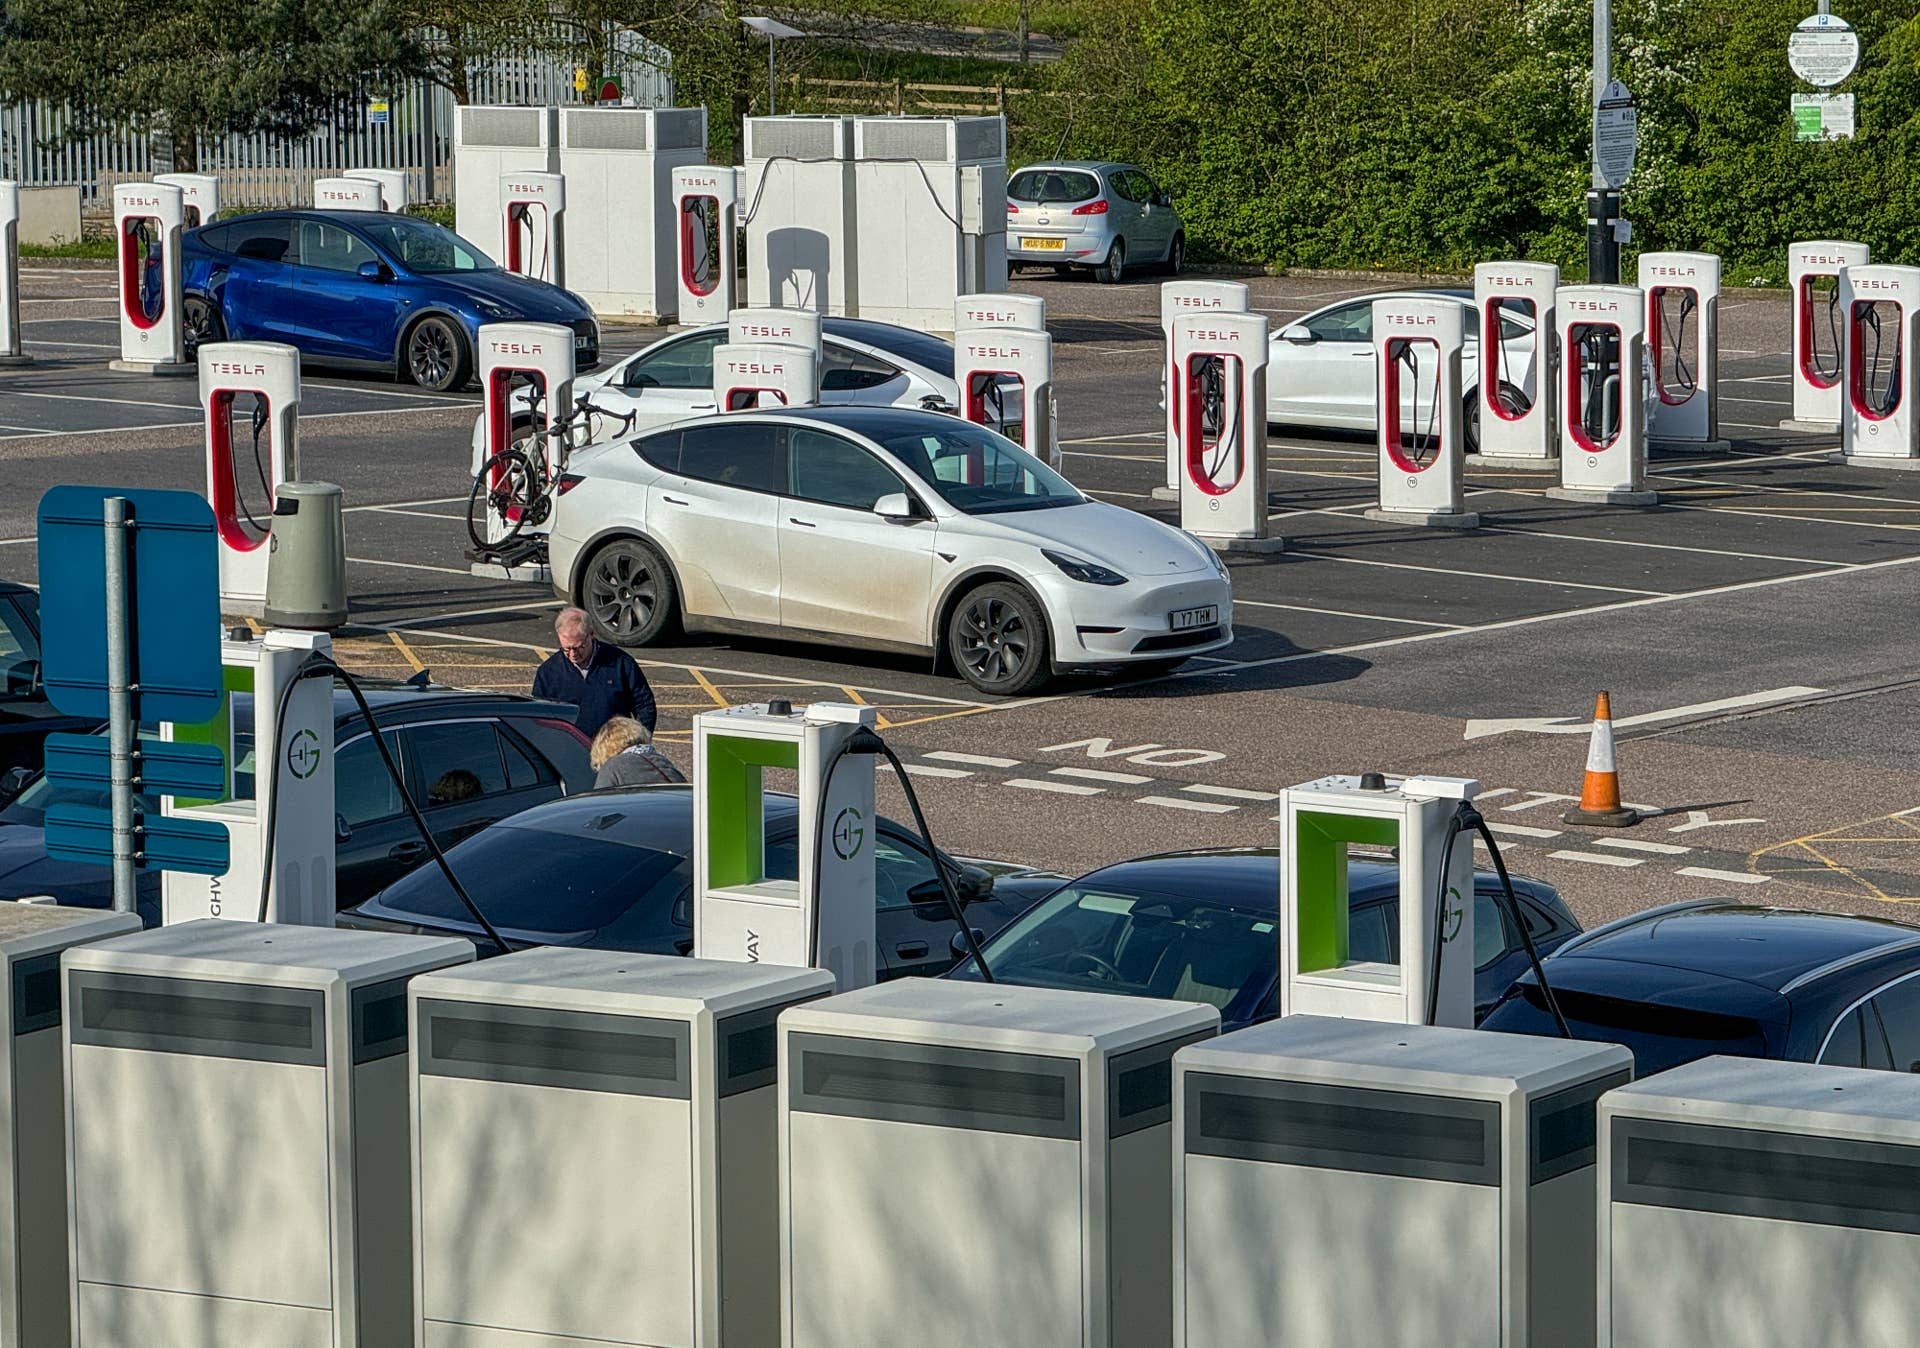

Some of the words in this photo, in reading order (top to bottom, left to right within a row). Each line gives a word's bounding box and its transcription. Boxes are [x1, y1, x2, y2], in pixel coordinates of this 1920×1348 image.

[323, 192, 359, 200] TESLA
[123, 198, 159, 206] TESLA
[1801, 256, 1845, 264] TESLA
[1651, 267, 1695, 276] TESLA
[1487, 277, 1532, 286] TESLA
[1853, 280, 1899, 289] TESLA
[1174, 297, 1221, 307] TESLA
[1569, 301, 1617, 310] TESLA
[967, 312, 1015, 321] TESLA
[1386, 315, 1435, 324] TESLA
[741, 326, 791, 337] TESLA
[1188, 330, 1239, 340] TESLA
[491, 343, 541, 354] TESLA
[968, 347, 1020, 358] TESLA
[211, 363, 264, 375] TESLA
[728, 363, 783, 374] TESLA
[1181, 612, 1192, 625] Y7
[1037, 738, 1226, 767] NO
[210, 877, 221, 920] GHW
